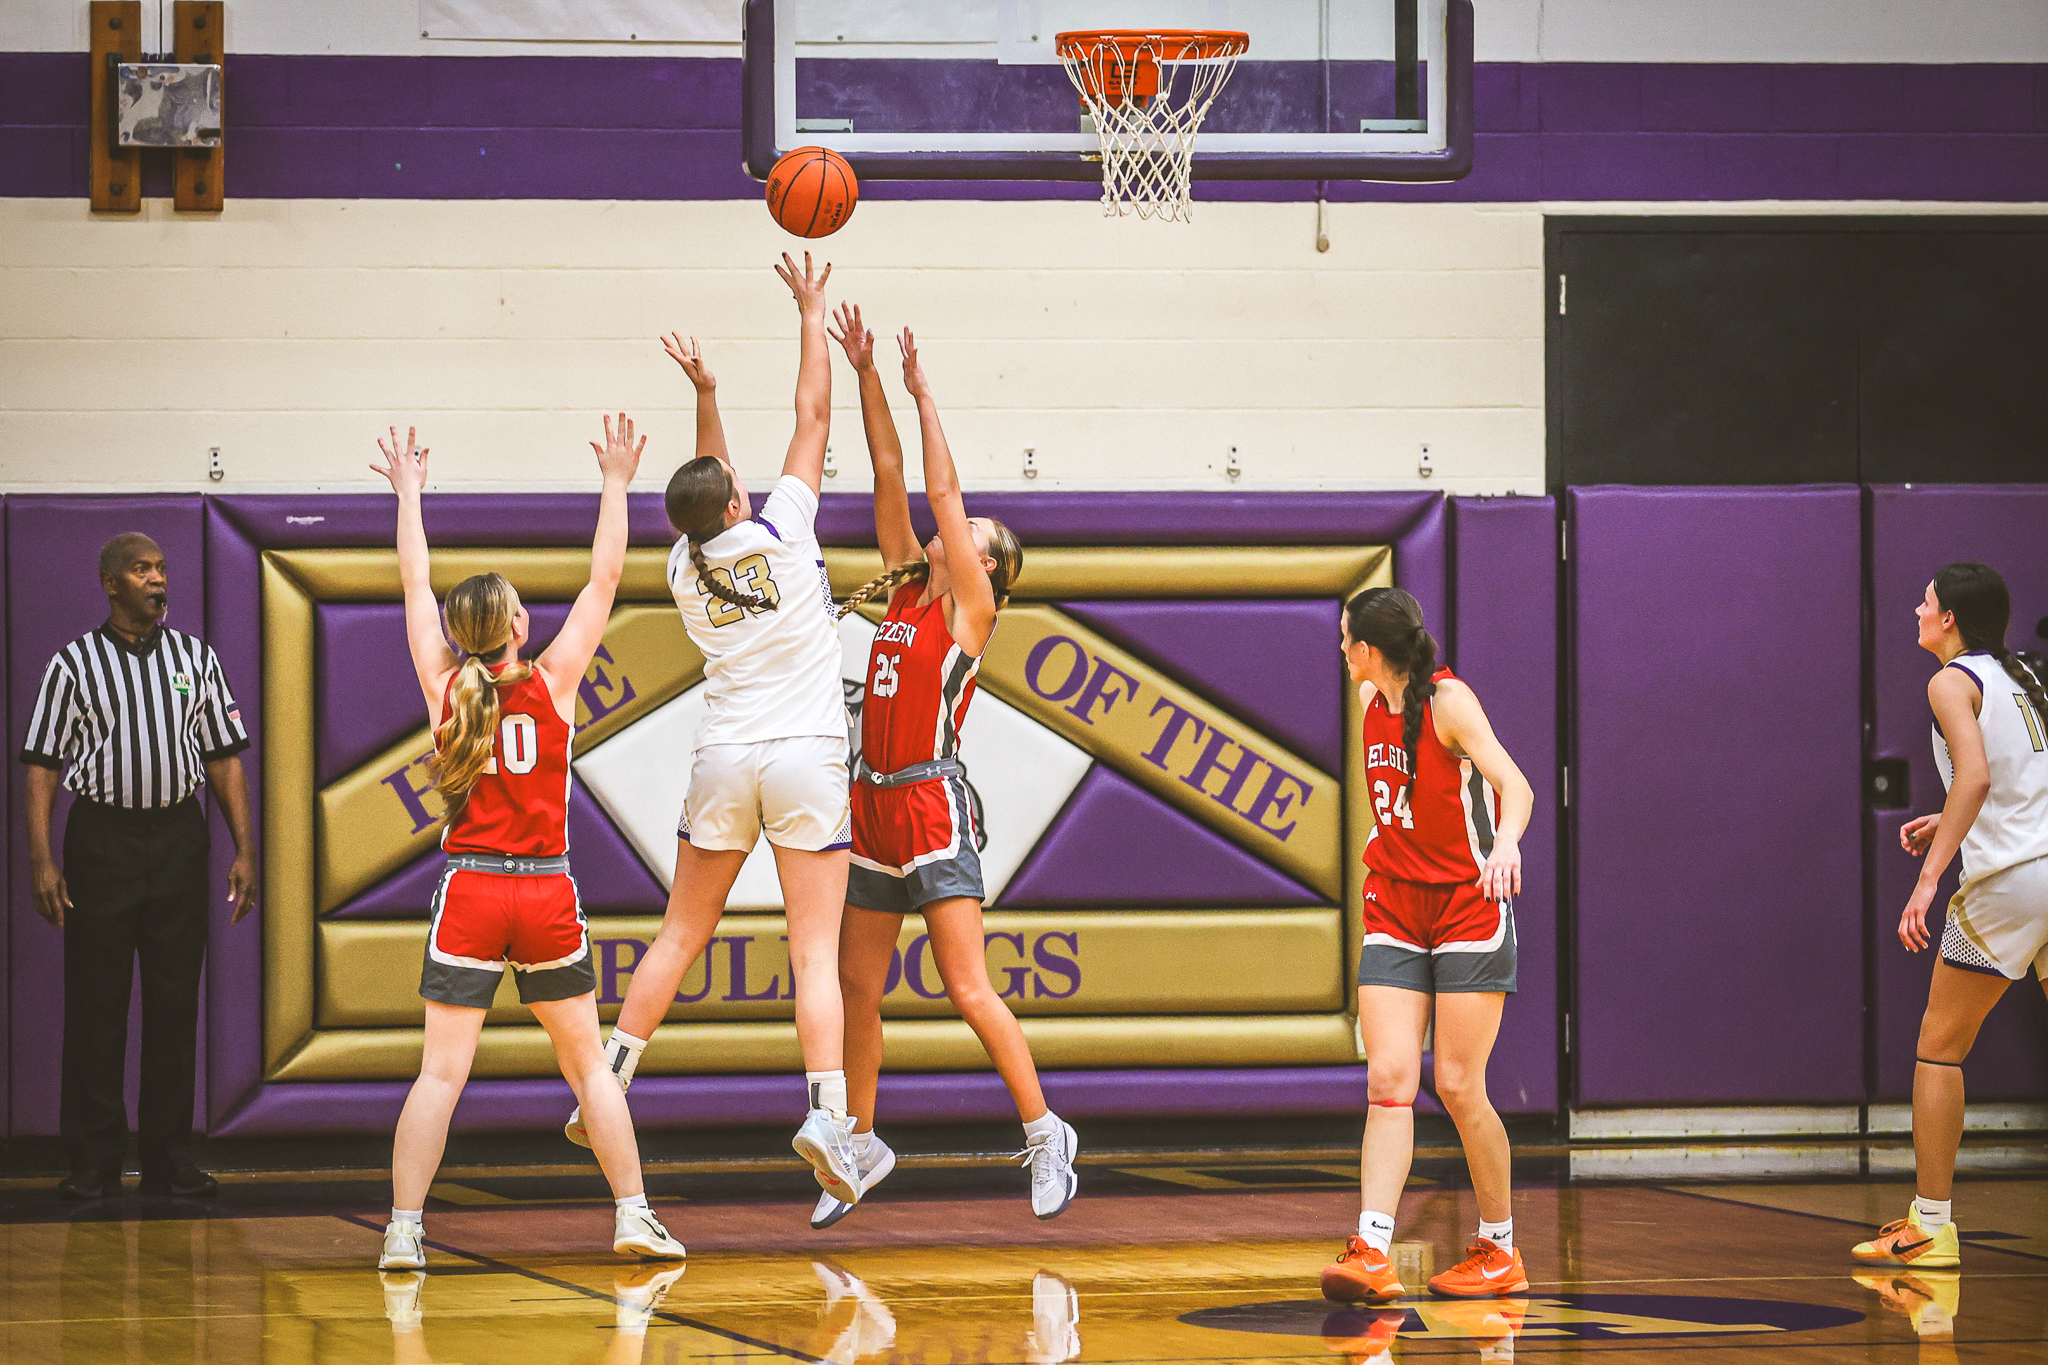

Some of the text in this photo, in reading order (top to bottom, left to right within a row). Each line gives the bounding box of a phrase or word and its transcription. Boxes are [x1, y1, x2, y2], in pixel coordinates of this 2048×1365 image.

[696, 553, 781, 628] 23
[872, 652, 901, 699] 25
[380, 643, 638, 836] HE
[481, 712, 538, 776] 0
[1025, 634, 1314, 842] OF THE
[2012, 692, 2048, 753] 1
[1373, 779, 1415, 830] 24
